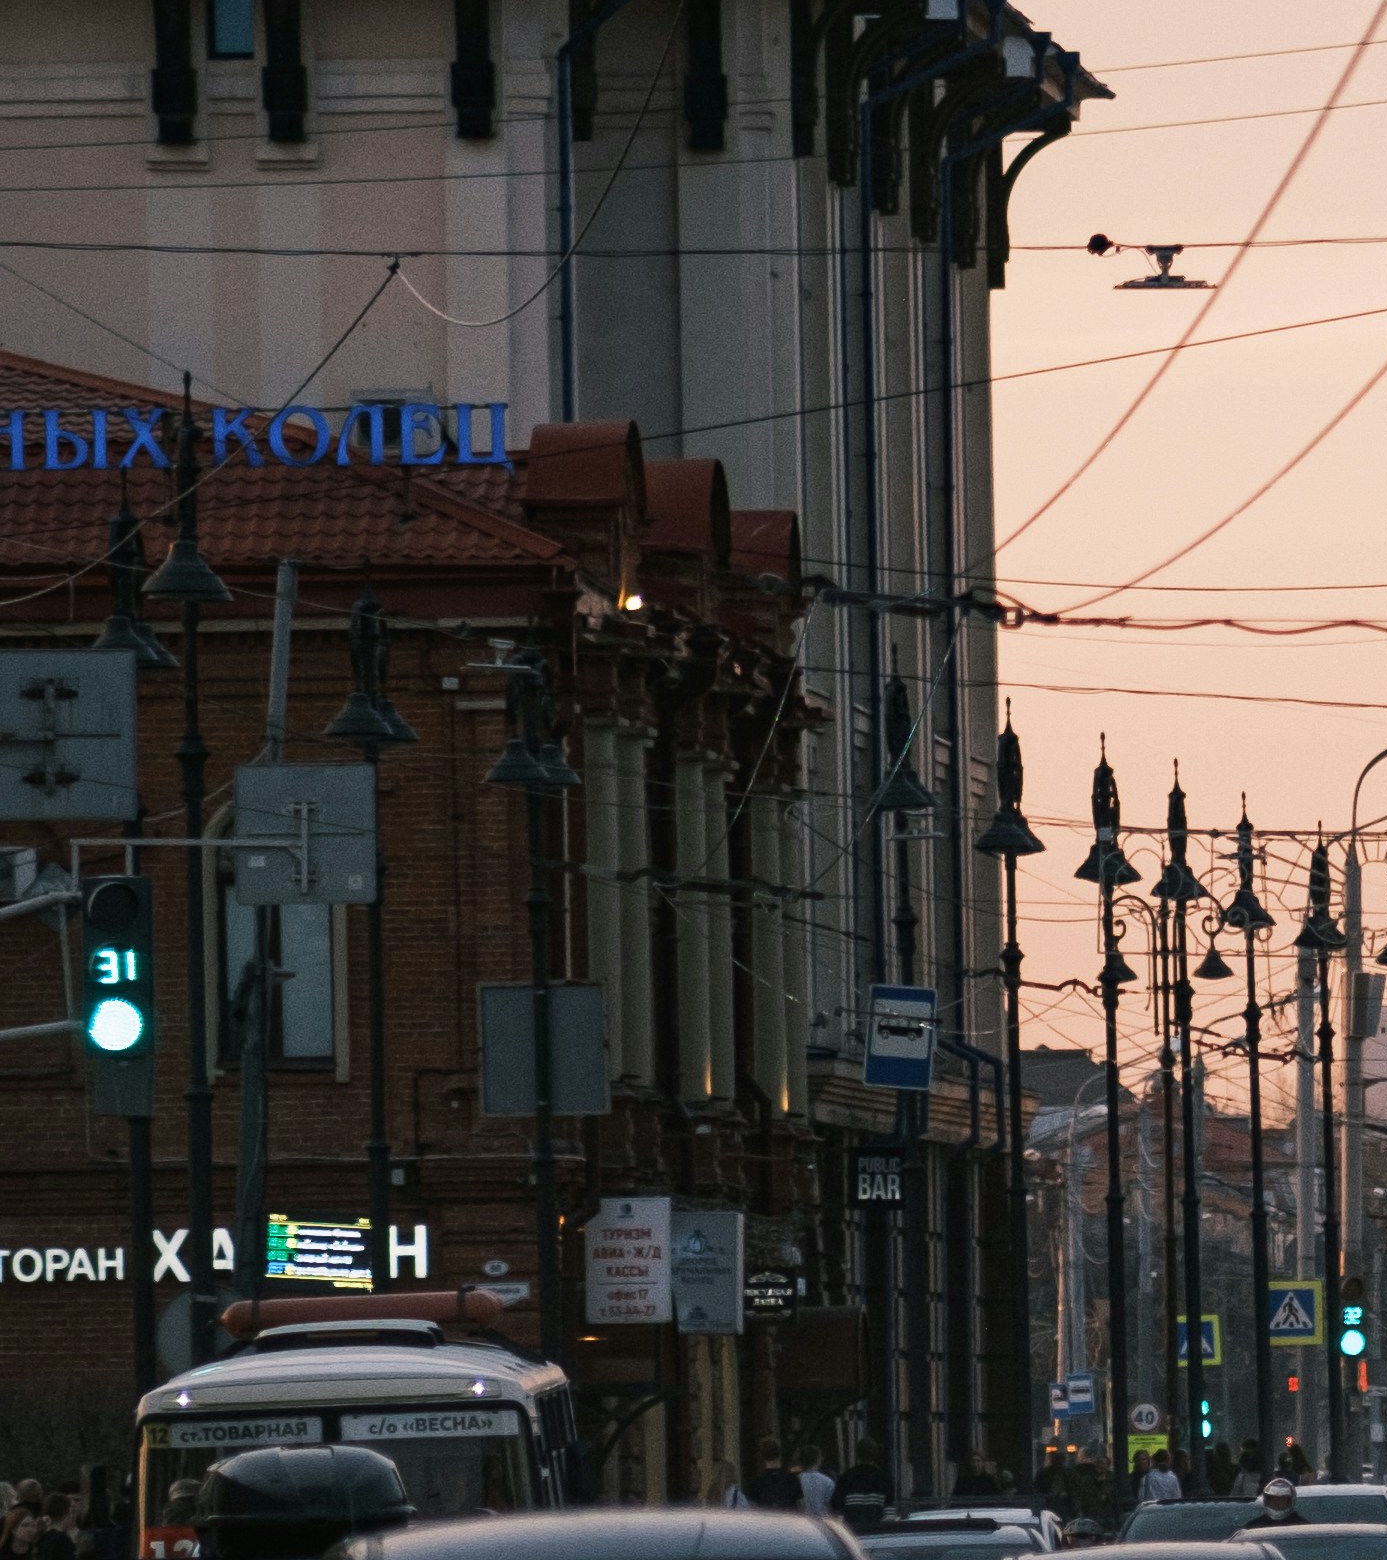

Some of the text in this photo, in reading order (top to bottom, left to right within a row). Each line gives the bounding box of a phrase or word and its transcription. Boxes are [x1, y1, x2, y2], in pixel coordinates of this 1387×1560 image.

[212, 403, 515, 477] КОЛЕЦ
[98, 949, 136, 983] 31
[857, 1156, 902, 1173] PUBLIC
[857, 1174, 901, 1201] BAR
[602, 1228, 652, 1241] ТУРИЗМ
[593, 1245, 661, 1260] АВИА Ж/Д
[606, 1266, 649, 1278] КАССЫ
[403, 1415, 494, 1434] «ВЕСНА»
[1134, 1411, 1155, 1425] 40
[151, 1427, 168, 1445] 12
